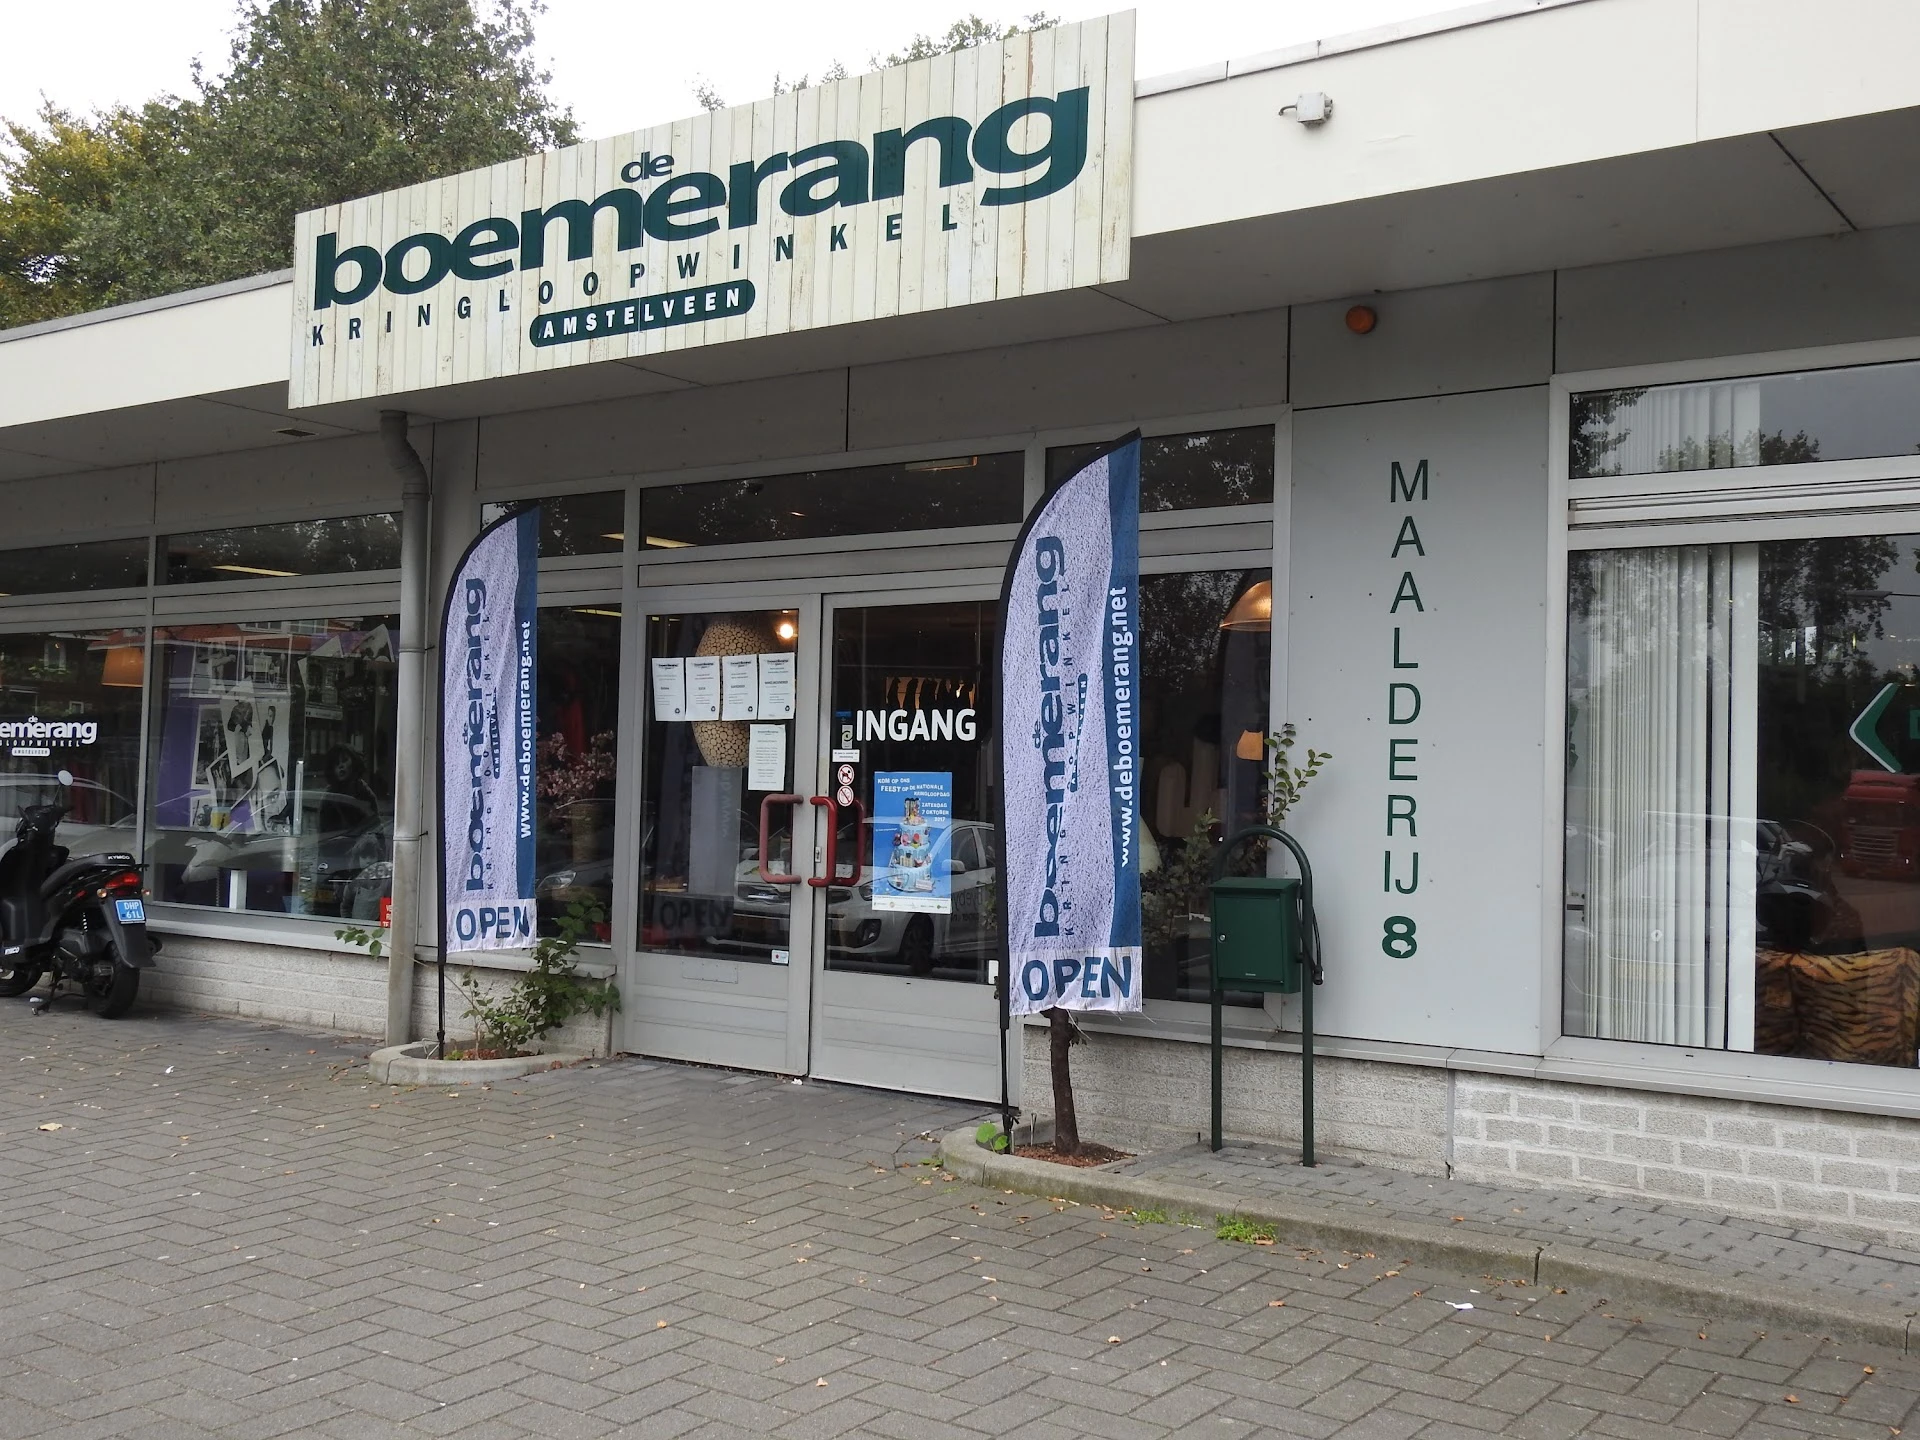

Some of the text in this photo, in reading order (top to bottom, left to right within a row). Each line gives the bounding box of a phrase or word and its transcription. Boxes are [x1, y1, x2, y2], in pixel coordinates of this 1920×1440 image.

[314, 86, 1091, 311] boemerang
[620, 151, 675, 184] de
[312, 203, 958, 347] KRINGLOOPWINKEL
[542, 287, 741, 339] AMSTELVEEN
[465, 577, 487, 891] boemerang
[519, 620, 533, 839] www.deboemerang.net
[856, 708, 977, 741] INGANG
[1034, 536, 1066, 938] boemerang
[1109, 586, 1134, 867] www.deboemerang.net
[1382, 459, 1429, 959] MAALDERIJ 8
[880, 785, 901, 793] FEEST
[123, 902, 139, 910] DHP
[455, 905, 531, 941] OPEN
[1021, 955, 1132, 1001] OPEN
